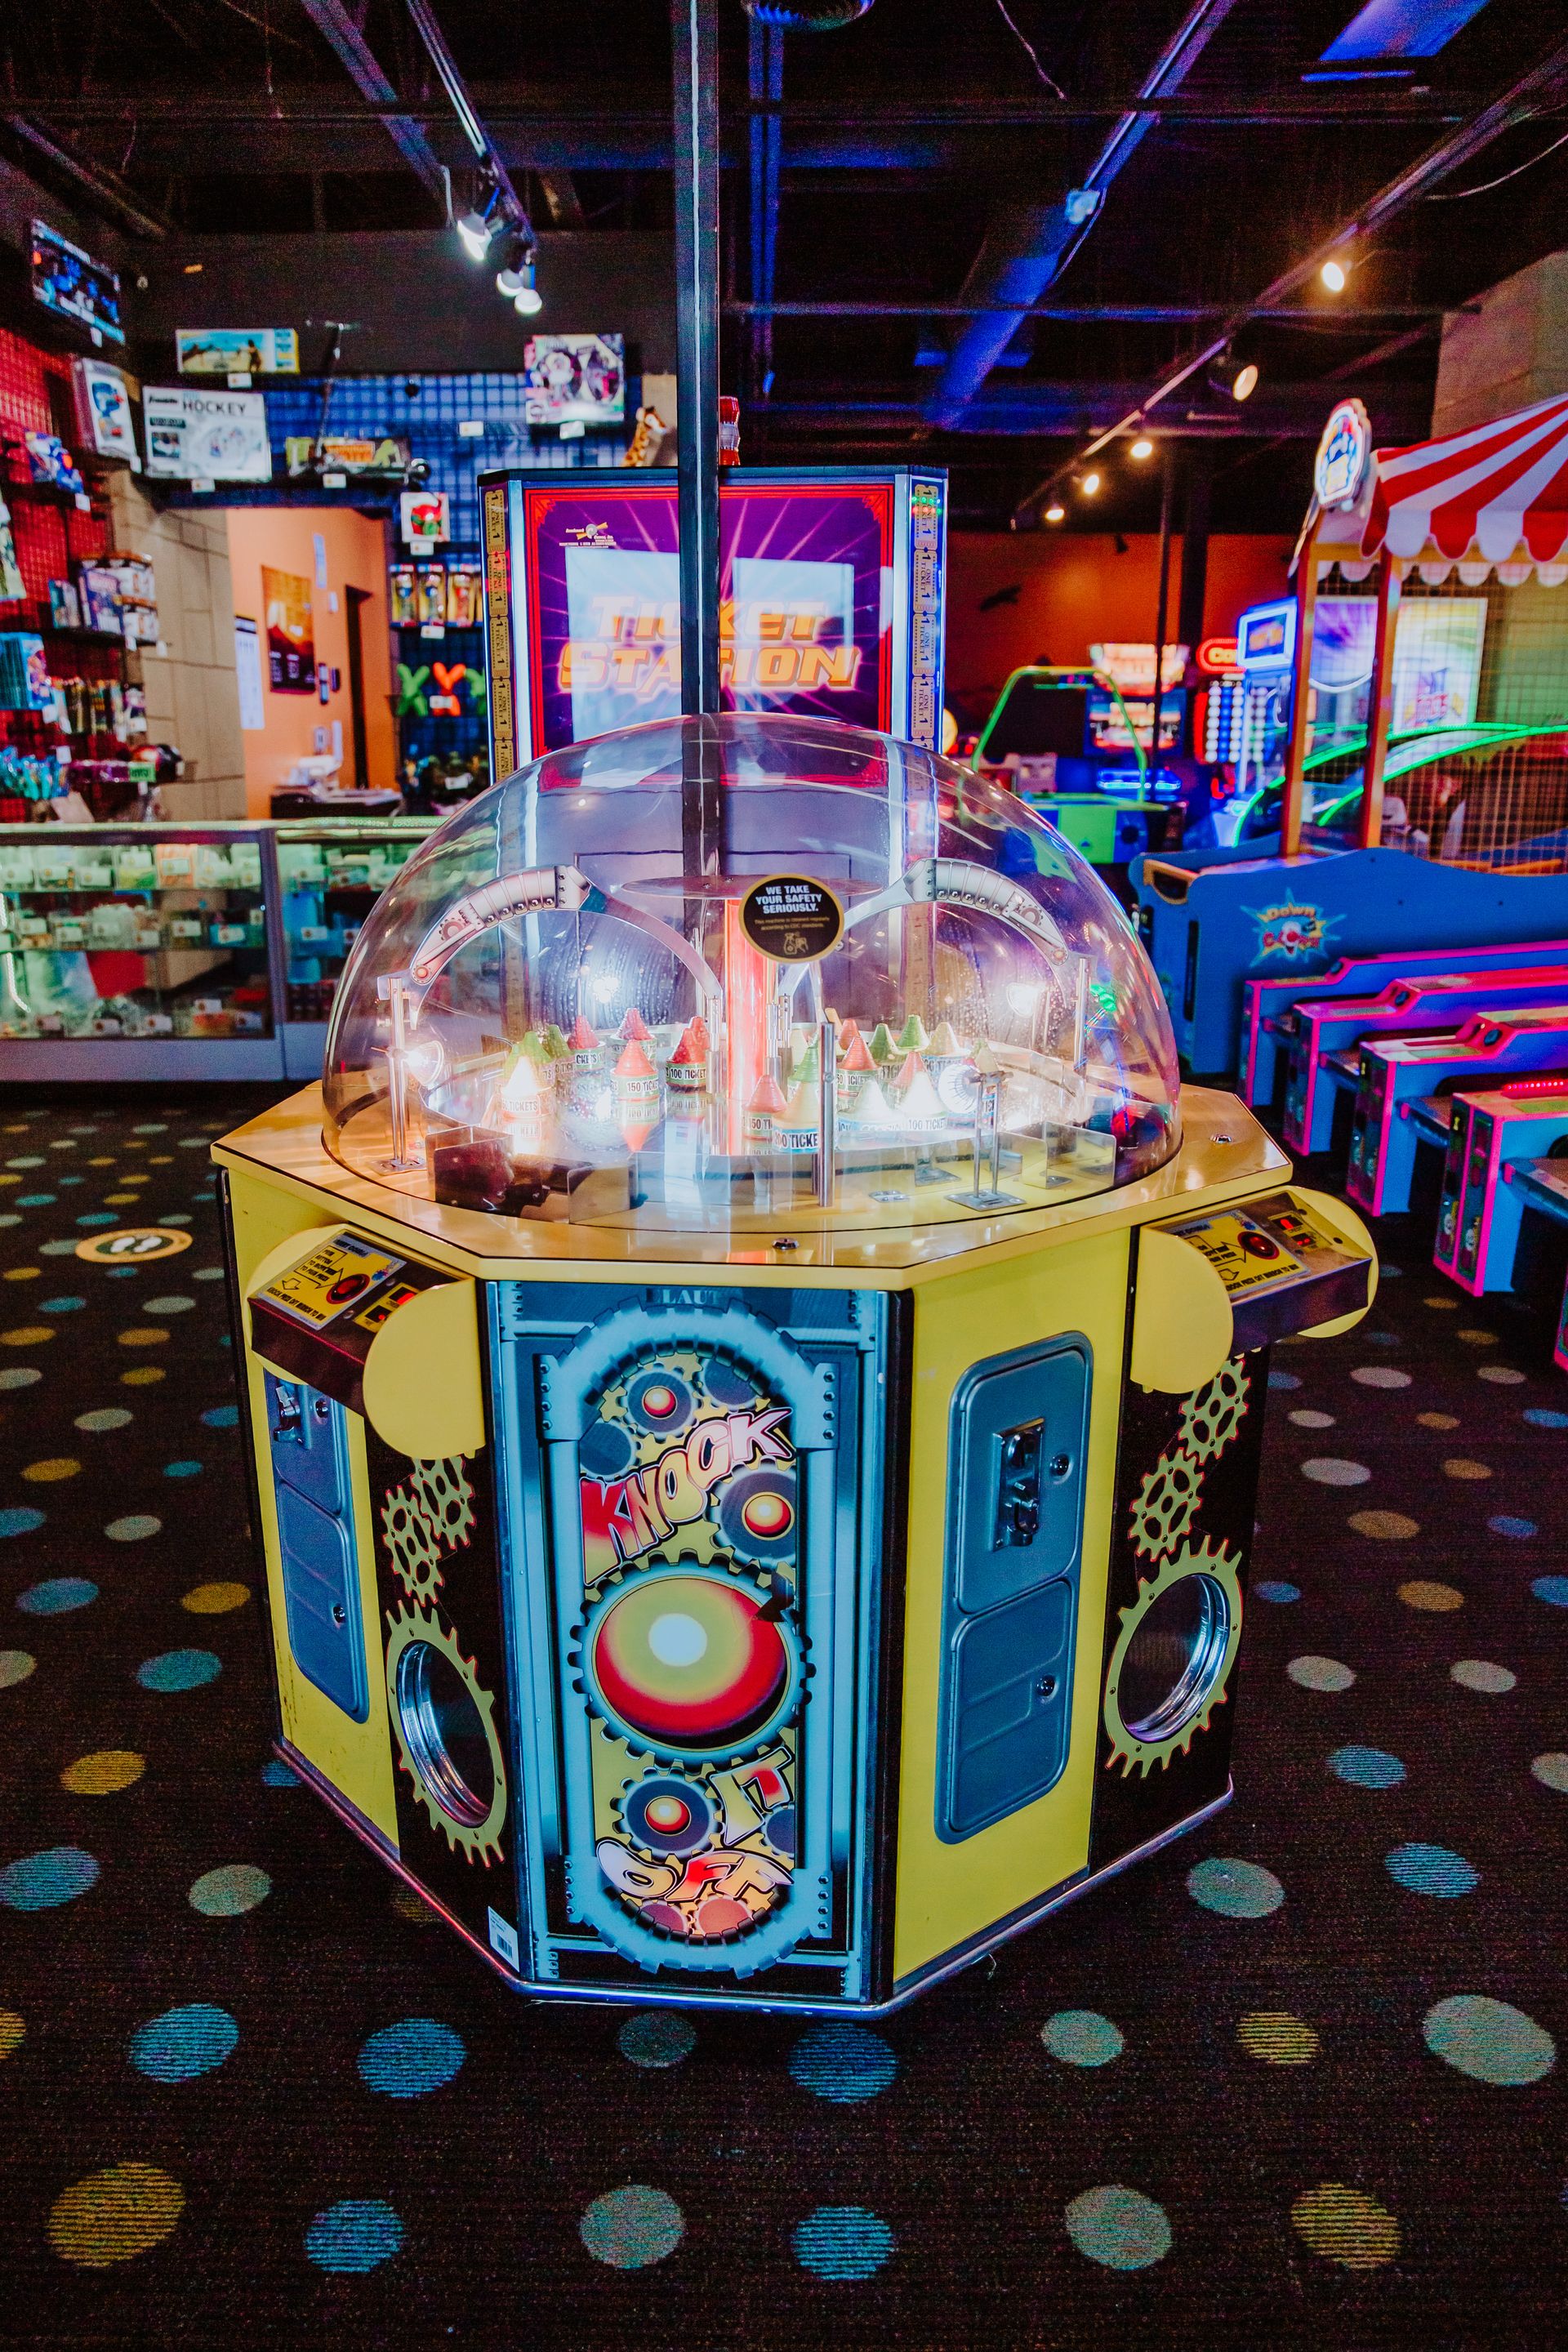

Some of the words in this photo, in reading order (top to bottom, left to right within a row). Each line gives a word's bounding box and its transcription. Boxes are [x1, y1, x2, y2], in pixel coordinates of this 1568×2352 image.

[183, 399, 246, 415] HOCKEY
[766, 886, 782, 895] WE
[784, 884, 809, 894] TAKE
[755, 896, 782, 905] YOUR
[785, 893, 822, 903] SAFETY
[763, 902, 818, 914] SERIOUSLY.
[670, 1068, 682, 1079] 100
[627, 1082, 641, 1092] 150
[509, 1101, 538, 1111] TICKETS
[909, 1119, 923, 1129] 100
[580, 1408, 792, 1585] KNOCK
[708, 1746, 792, 1846] IT
[595, 1839, 795, 1901] OFF
